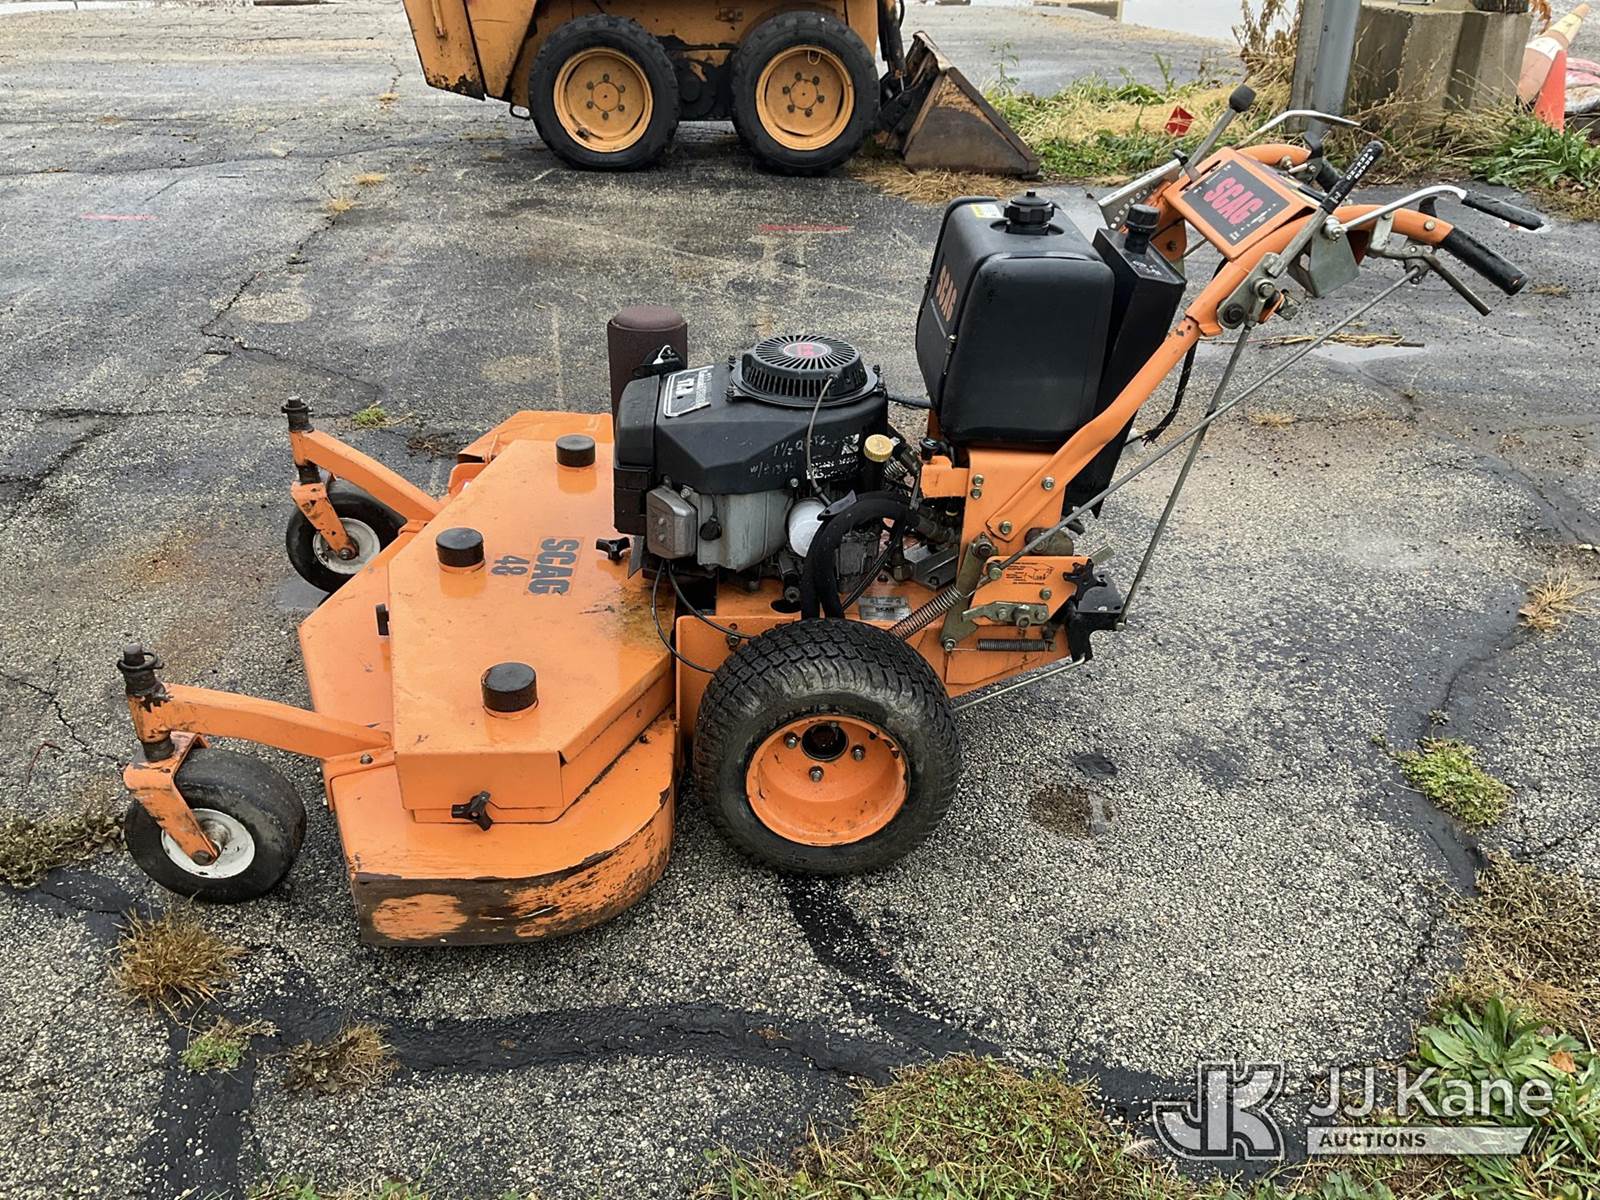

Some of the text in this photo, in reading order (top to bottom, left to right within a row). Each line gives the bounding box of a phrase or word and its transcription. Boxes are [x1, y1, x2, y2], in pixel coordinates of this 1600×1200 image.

[1203, 176, 1264, 225] SCAG
[936, 264, 958, 322] SCAG
[491, 555, 530, 576] 48
[528, 538, 580, 595] SCAG
